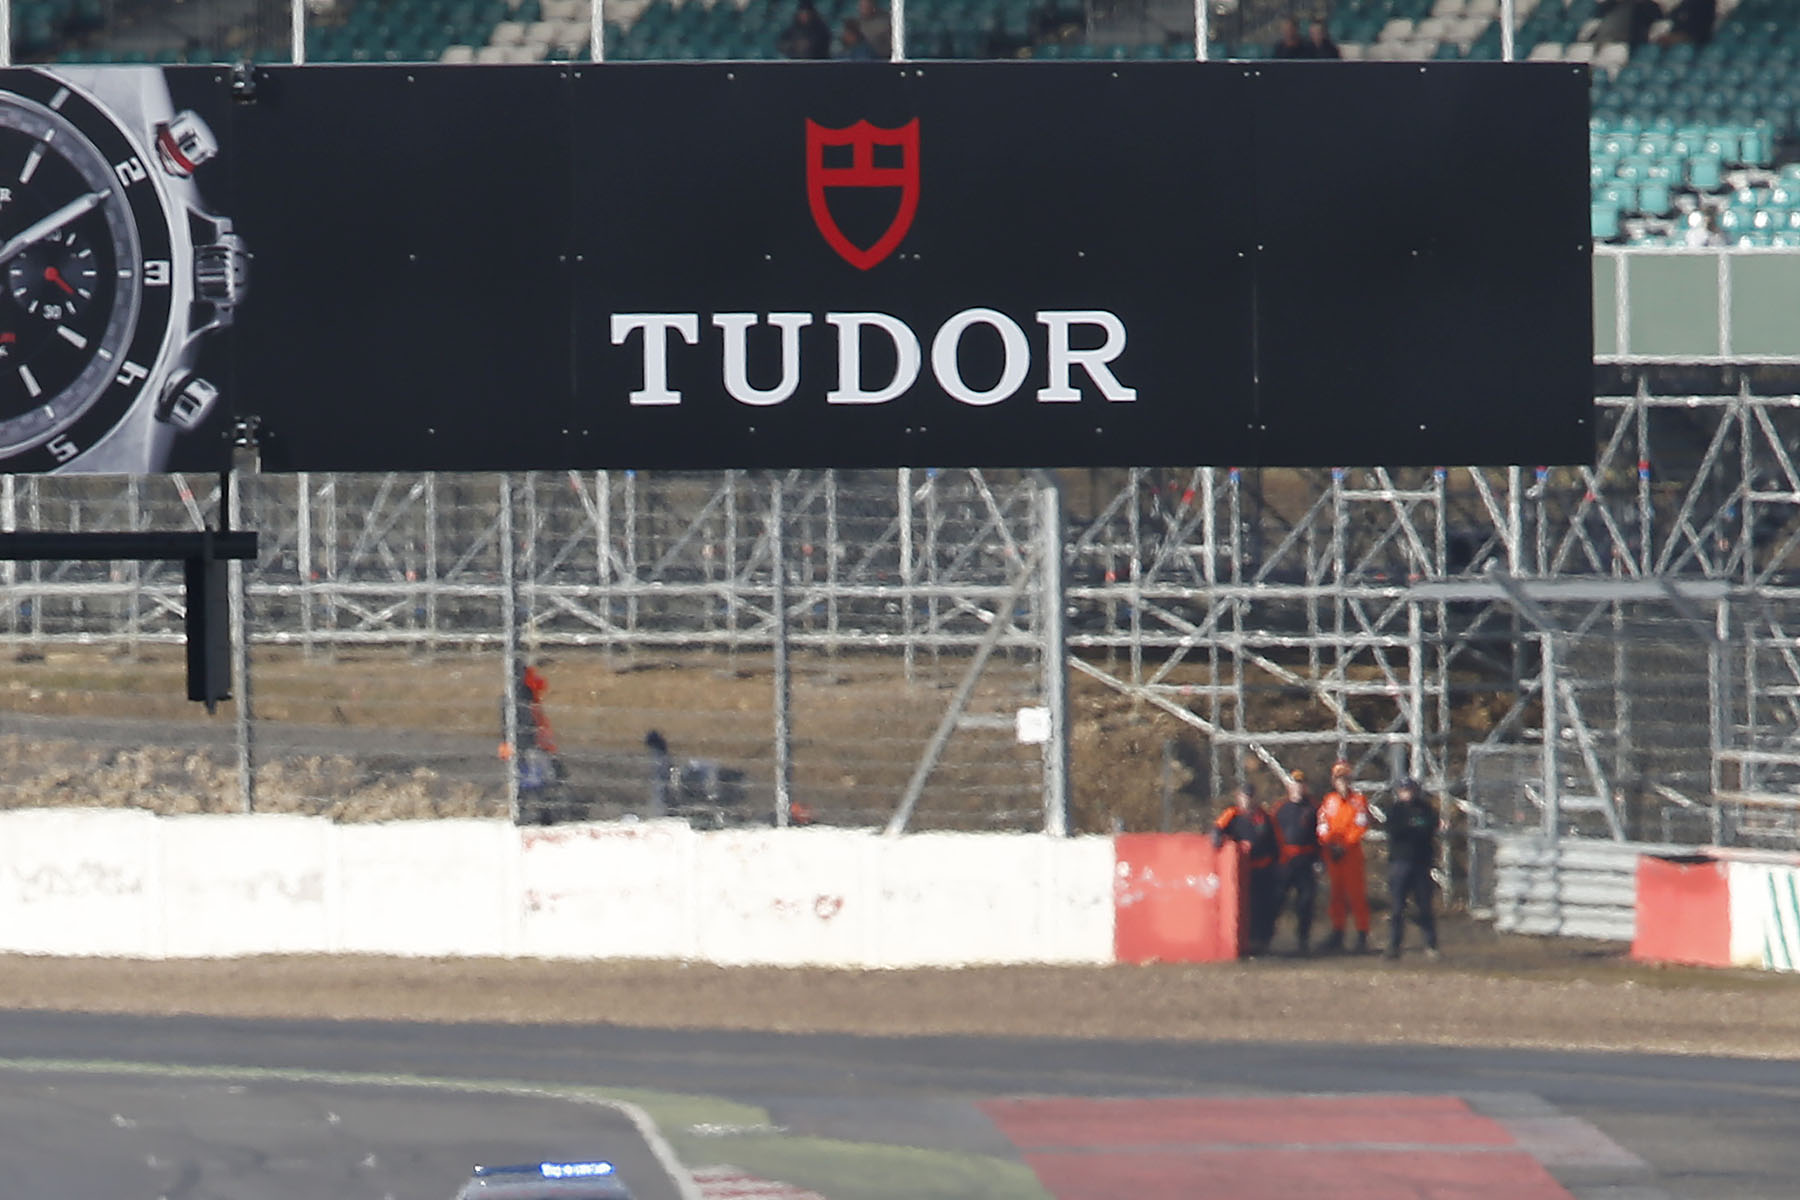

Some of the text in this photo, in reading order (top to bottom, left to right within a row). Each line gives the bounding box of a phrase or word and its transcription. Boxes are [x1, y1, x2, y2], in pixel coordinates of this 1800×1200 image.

[114, 157, 146, 187] 2
[143, 259, 171, 286] 3
[610, 307, 1137, 406] TUDOR
